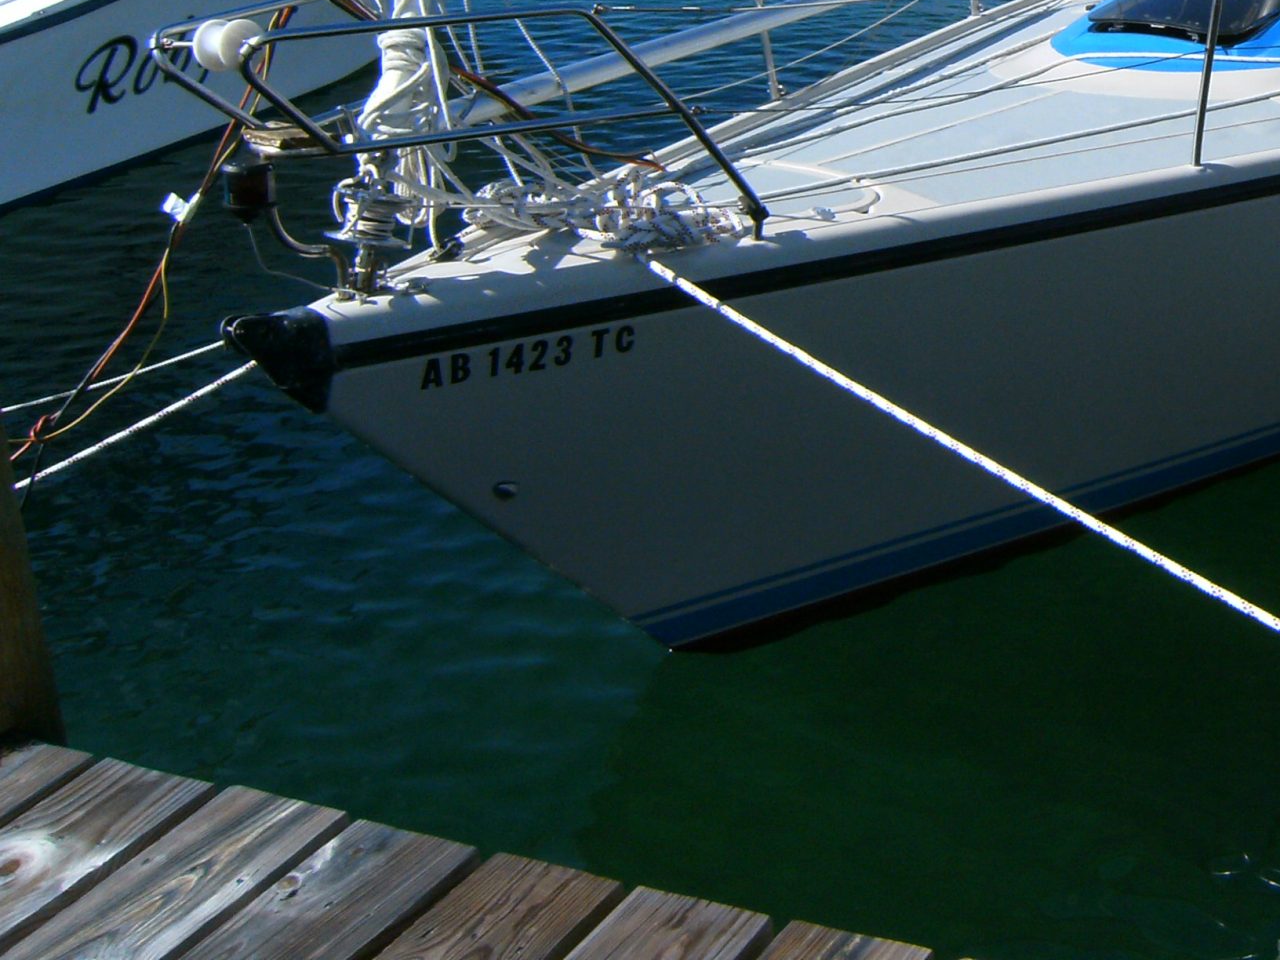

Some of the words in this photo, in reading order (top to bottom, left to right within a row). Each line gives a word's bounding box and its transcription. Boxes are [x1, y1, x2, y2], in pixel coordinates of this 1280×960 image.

[421, 352, 472, 390] AB
[488, 335, 574, 378] 1423
[591, 325, 636, 359] TC
